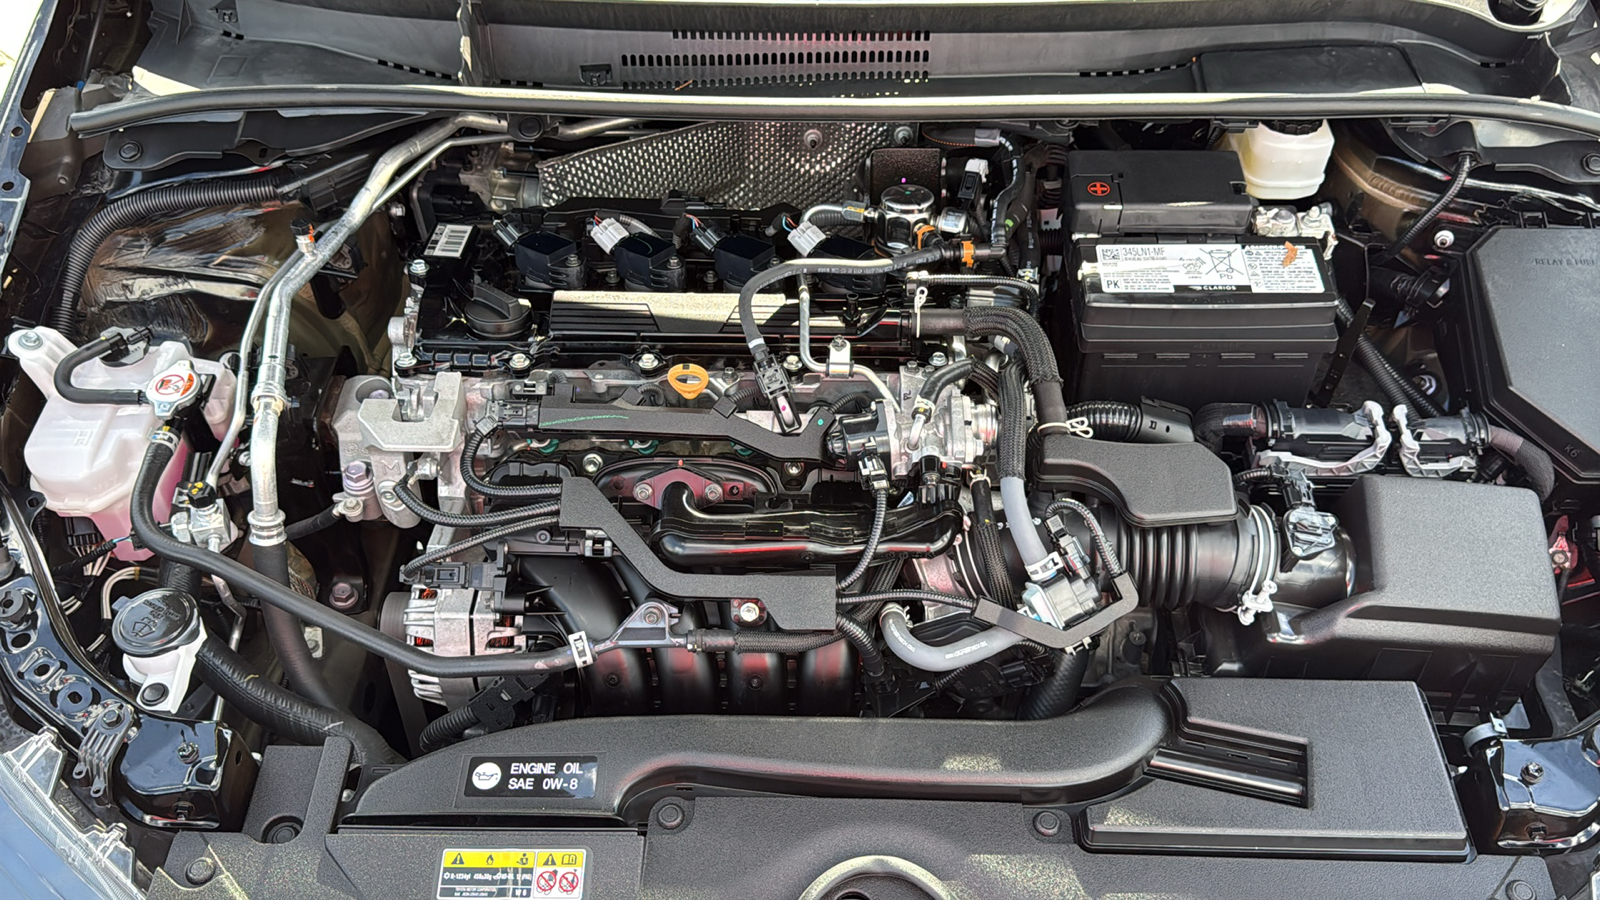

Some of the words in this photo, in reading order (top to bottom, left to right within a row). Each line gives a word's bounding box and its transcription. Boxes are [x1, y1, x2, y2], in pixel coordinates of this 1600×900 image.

[1122, 247, 1165, 256] 345LN1-MF
[1534, 258, 1563, 266] RELAY
[1106, 280, 1120, 289] PK
[1564, 443, 1580, 458] K6
[381, 459, 401, 476] M
[510, 762, 556, 774] ENGINE
[563, 762, 583, 774] OIL
[508, 778, 534, 789] SAE
[542, 778, 578, 790] 0W-8
